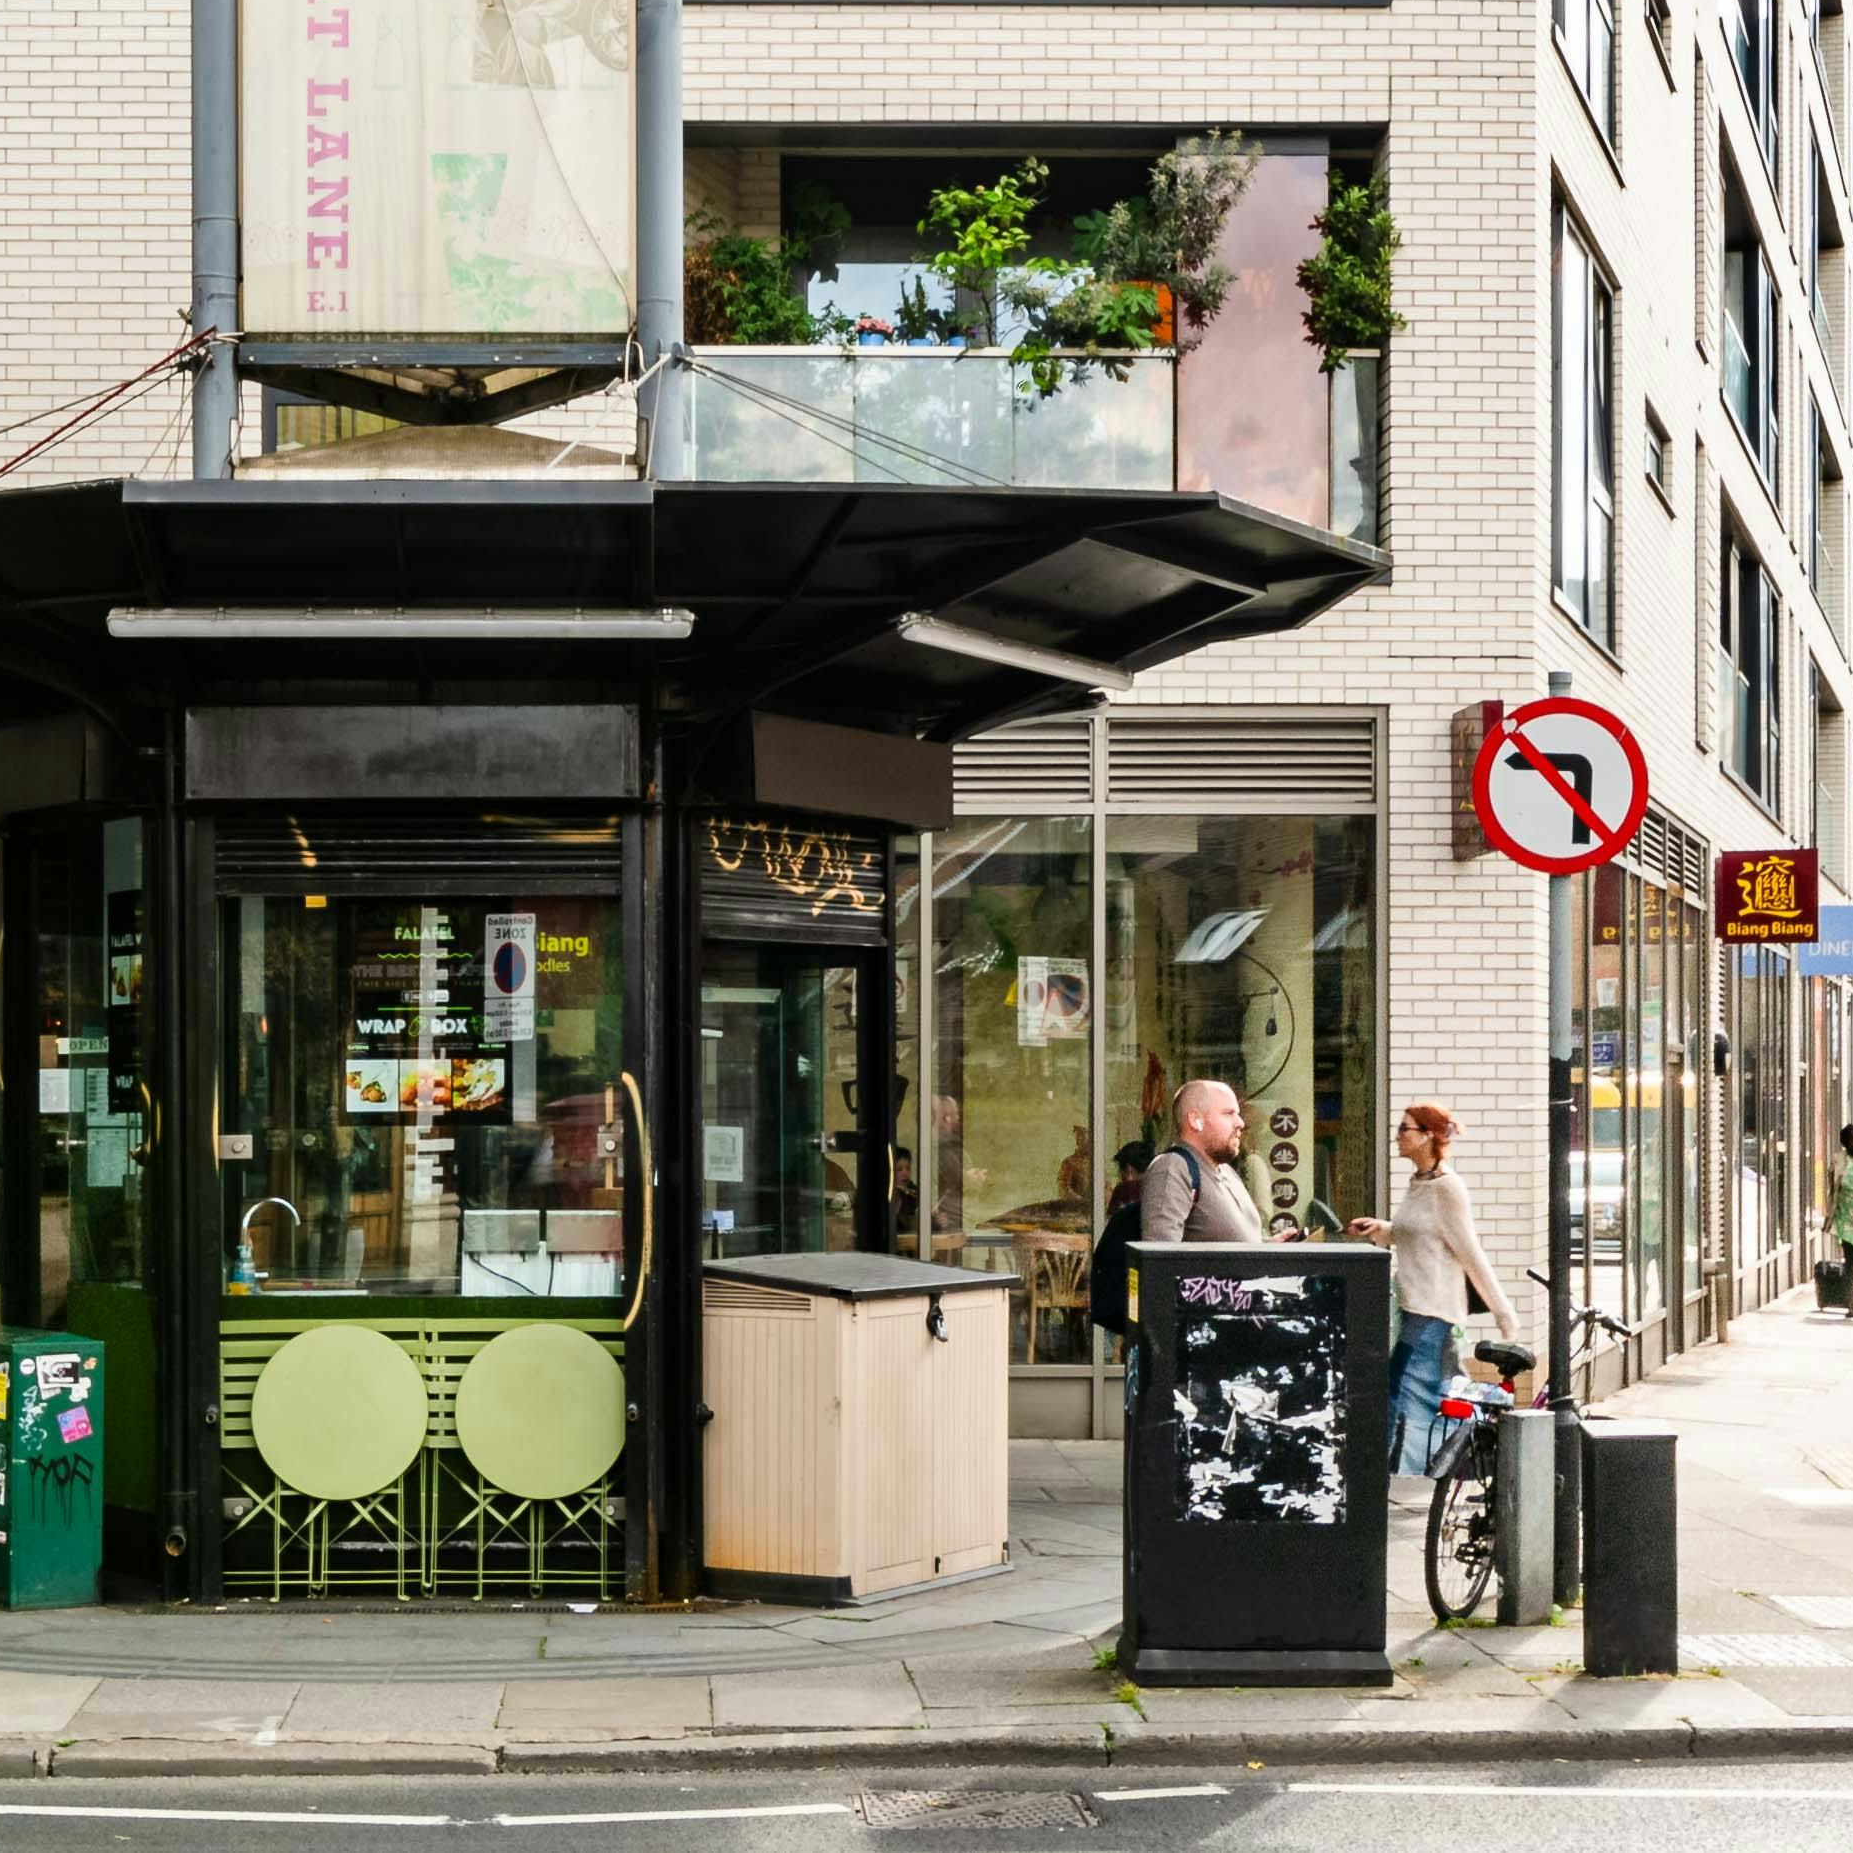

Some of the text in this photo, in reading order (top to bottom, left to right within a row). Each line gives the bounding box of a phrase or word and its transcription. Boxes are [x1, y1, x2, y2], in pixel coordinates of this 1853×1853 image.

[306, 77, 349, 269] LANE
[394, 926, 455, 940] FALAFEL
[1727, 921, 1814, 938] Biang Biang
[356, 1018, 407, 1035] WRAP
[430, 1018, 468, 1034] BOX
[69, 1039, 108, 1052] OPEN
